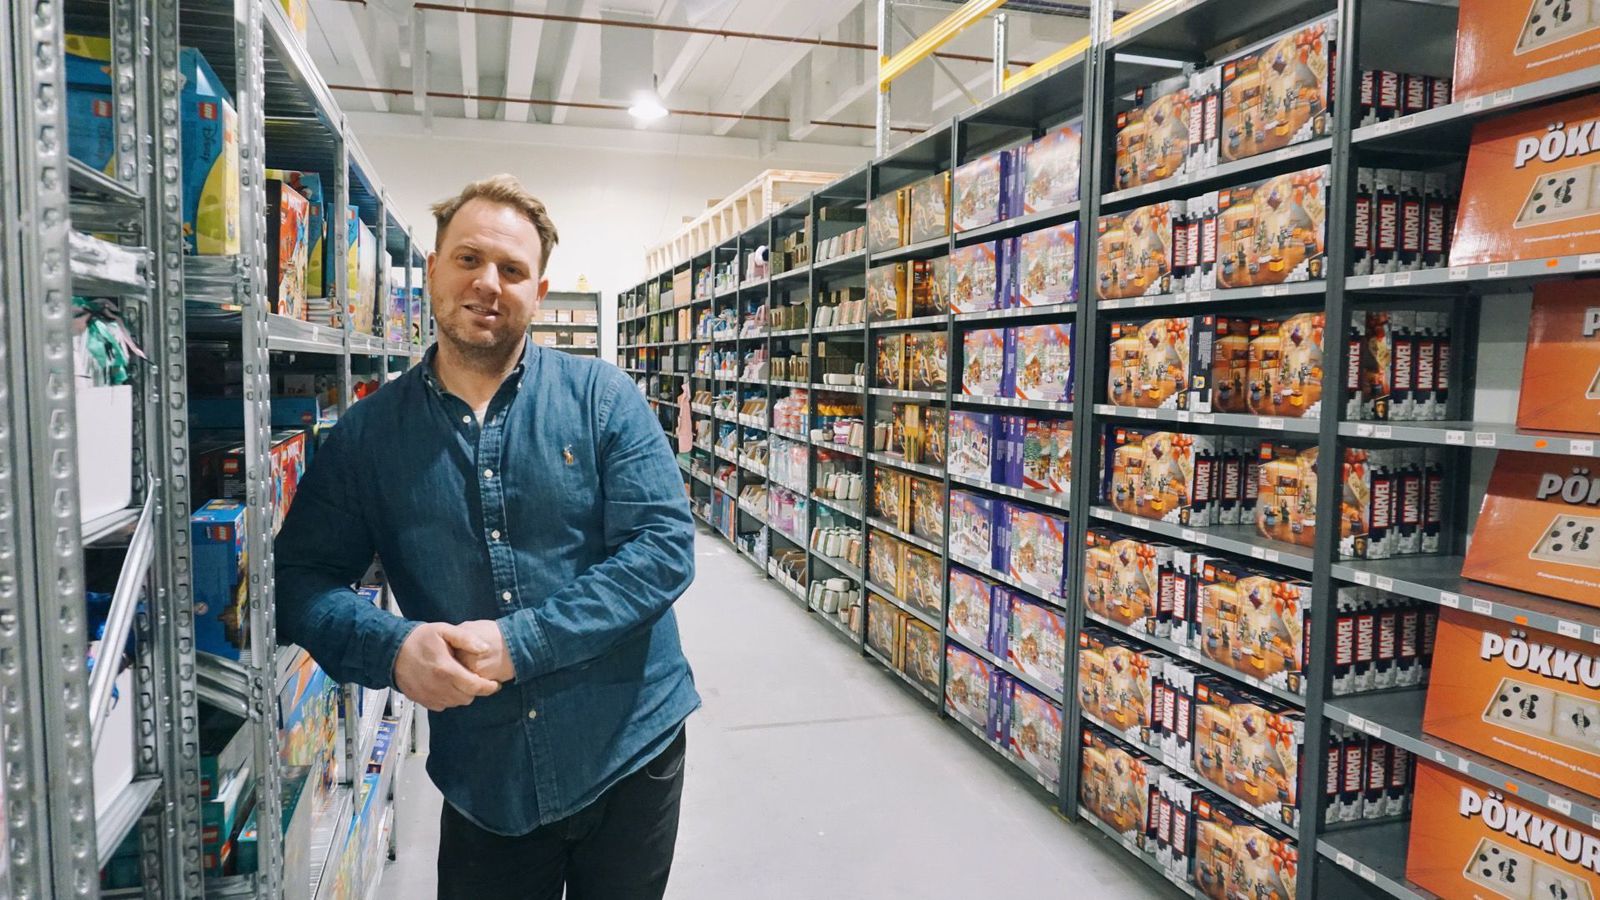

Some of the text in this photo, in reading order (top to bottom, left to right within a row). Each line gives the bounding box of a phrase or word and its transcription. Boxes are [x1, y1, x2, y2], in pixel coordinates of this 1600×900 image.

[1381, 71, 1397, 106] MARV
[1204, 97, 1216, 140] MARVEL
[1187, 224, 1198, 265] MARVEL
[1203, 221, 1216, 263] MARVEL
[1355, 201, 1369, 247] MARVEL
[1380, 203, 1396, 248] MARVEL
[1404, 204, 1419, 250] MARVEL
[1428, 206, 1443, 251] MARVEL
[1348, 342, 1360, 388] MARVEL
[1395, 343, 1411, 389] MARVEL
[1418, 343, 1434, 389] MARVEL
[1197, 462, 1210, 500] MARVEL
[1225, 462, 1238, 498] MARVEL
[1404, 480, 1419, 523] MARVEL
[1374, 481, 1390, 527] MARVEL
[1161, 574, 1174, 611] MARVEL
[1174, 580, 1186, 618] MARVEL
[1337, 621, 1353, 664] MARVEL
[1357, 617, 1373, 661] MARVEL
[1380, 616, 1395, 659] MARVEL
[1402, 614, 1418, 656] MARVEL
[1163, 690, 1175, 730] MARVEL
[1178, 698, 1190, 739] MARVEL
[1327, 750, 1338, 793] MARVEL
[1346, 750, 1361, 791] MARVEL
[1370, 746, 1386, 788] MARVEL
[1159, 802, 1171, 842] MARVEL
[1174, 811, 1186, 853] MARVEL
[1459, 788, 1600, 875] PÖKKUR
